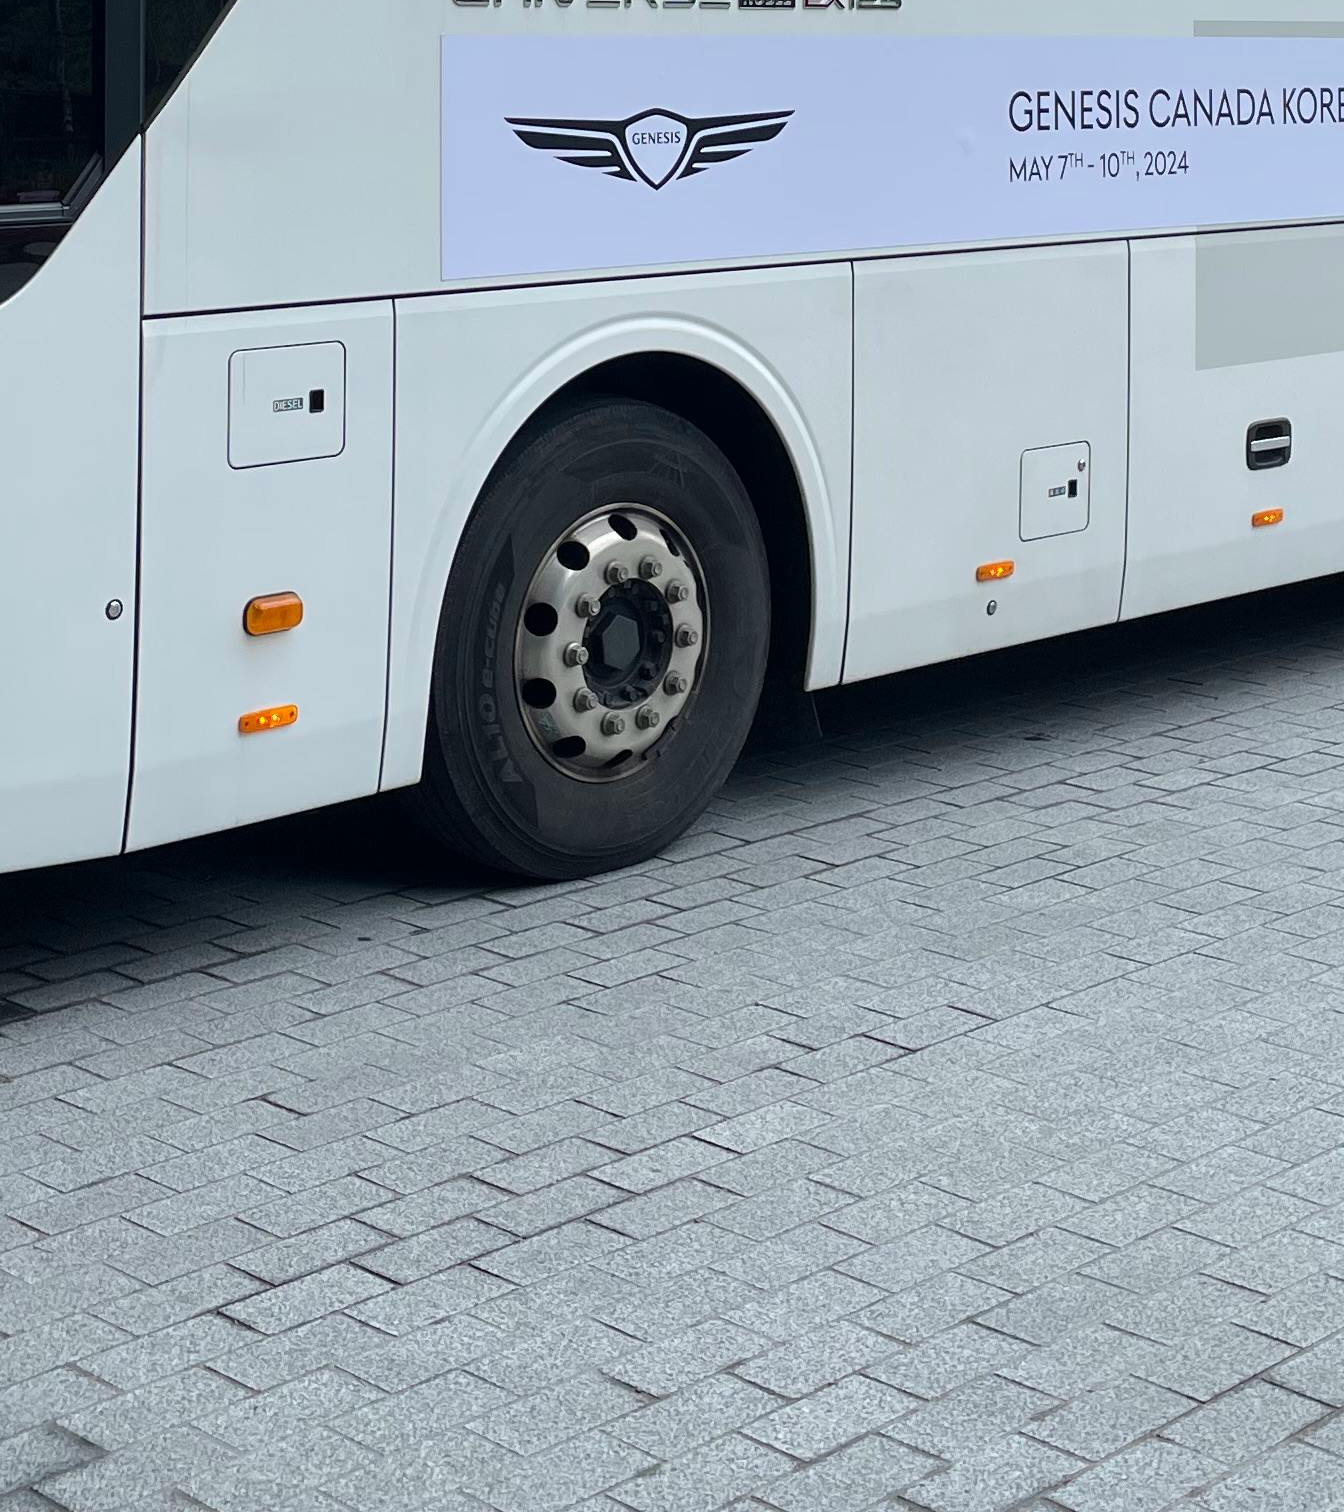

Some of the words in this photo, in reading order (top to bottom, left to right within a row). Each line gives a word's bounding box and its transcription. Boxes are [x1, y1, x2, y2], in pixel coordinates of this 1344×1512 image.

[1009, 89, 1139, 132] GENESIS
[1149, 88, 1275, 128] CANADA
[631, 131, 682, 145] GENESIS
[1009, 155, 1053, 182] MAY
[1143, 150, 1190, 176] 2024
[273, 399, 303, 412] DIESEL
